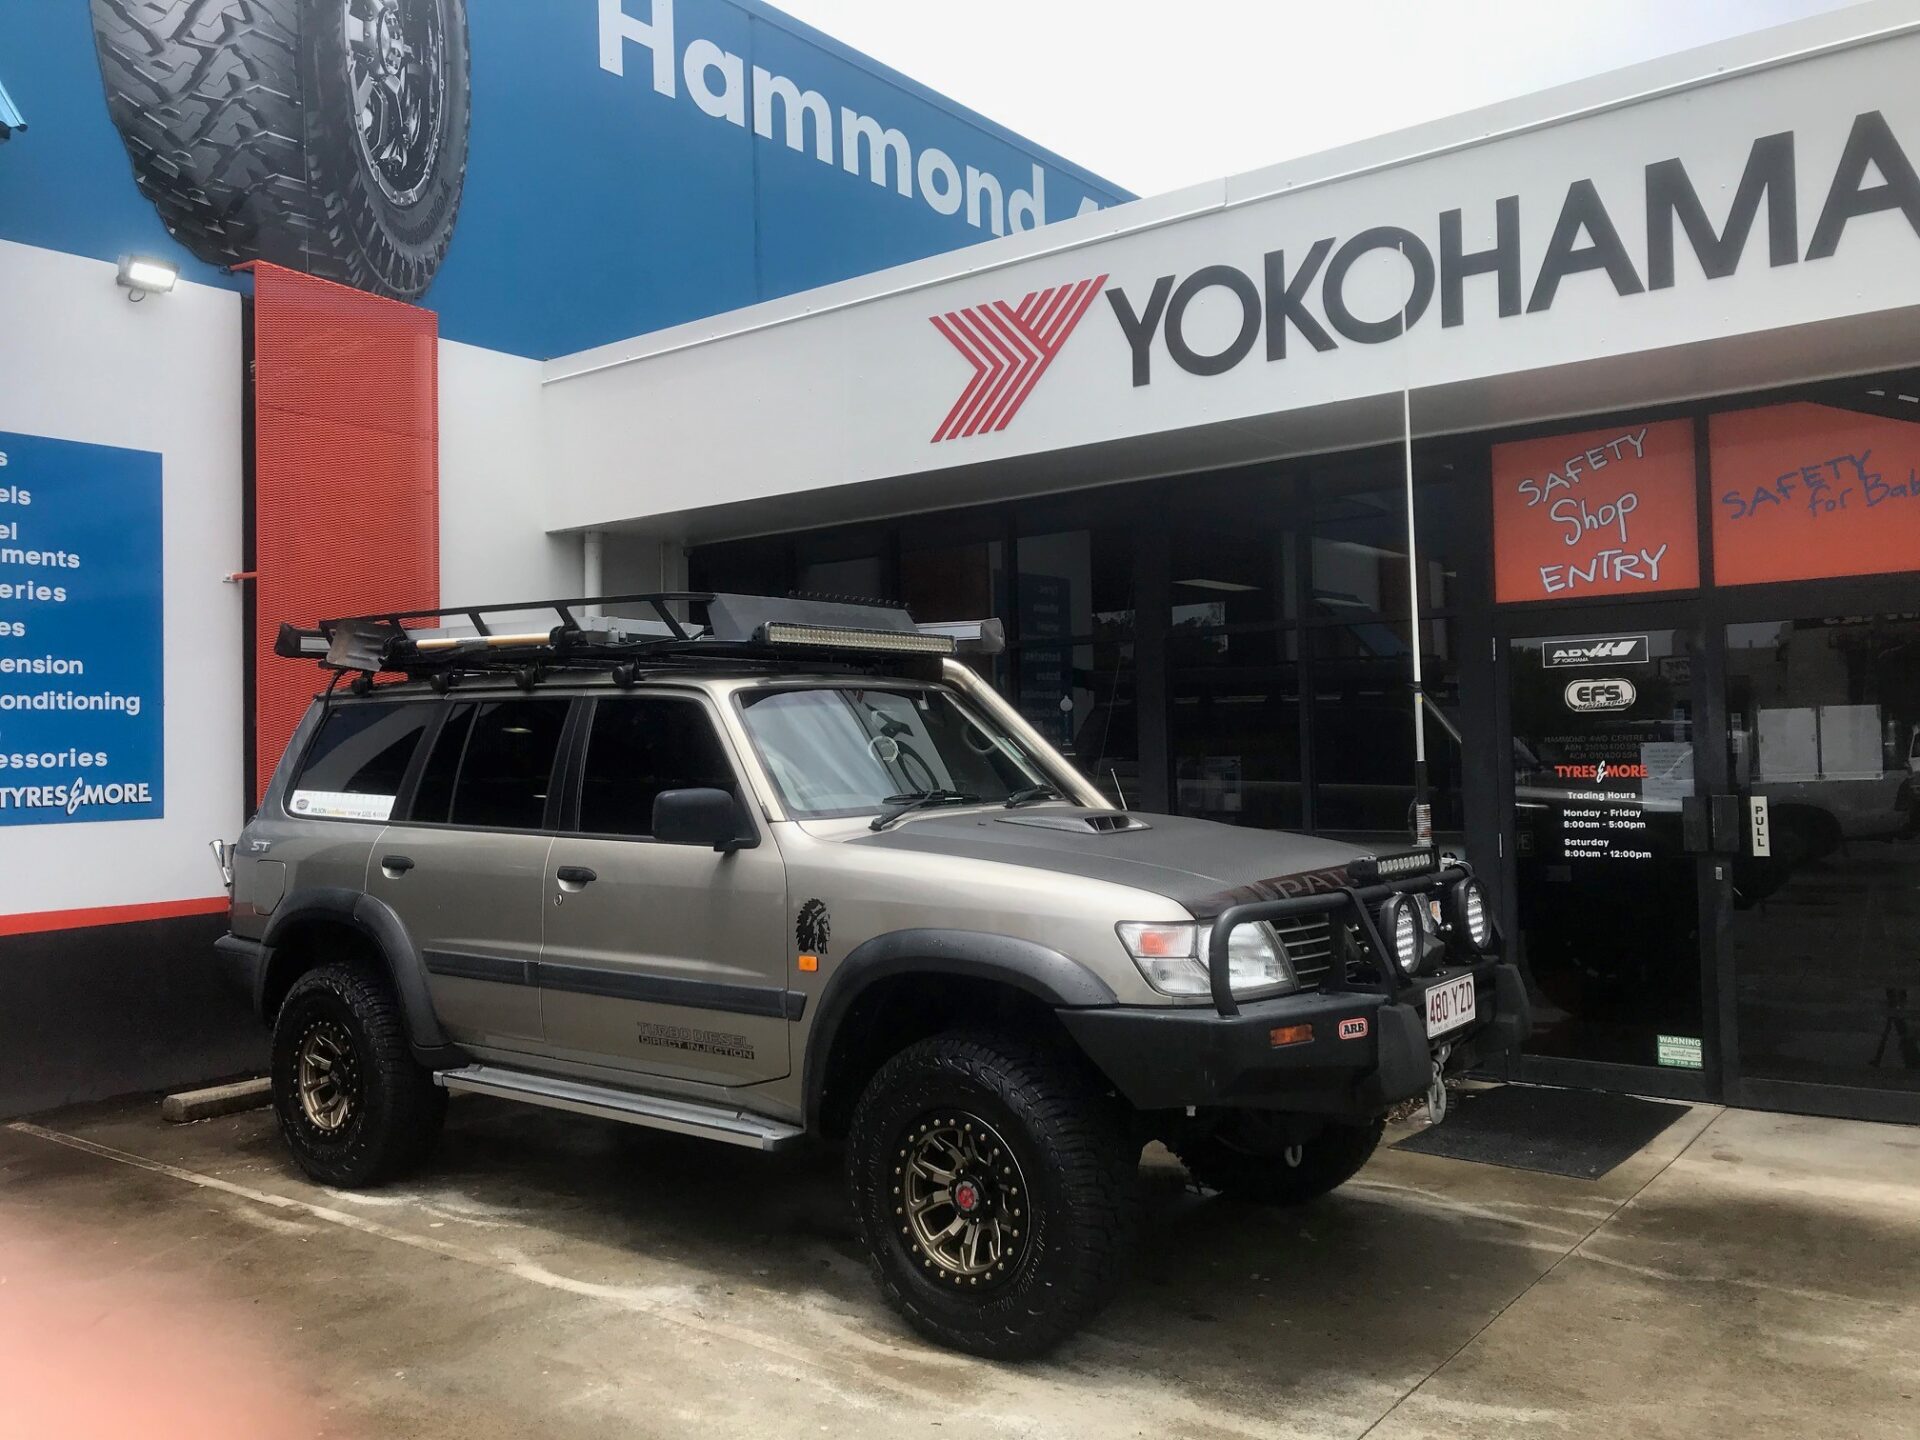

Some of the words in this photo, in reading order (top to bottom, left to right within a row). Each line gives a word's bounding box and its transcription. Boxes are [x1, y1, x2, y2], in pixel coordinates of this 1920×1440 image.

[598, 0, 1046, 237] Hammond
[1105, 110, 1920, 387] YOKOHAMA
[1518, 428, 1647, 506] SAFETY
[1722, 449, 1872, 520] SAFETY
[1808, 486, 1853, 518] for
[1550, 493, 1638, 546] Shop
[1, 547, 80, 569] ments
[1539, 544, 1667, 593] ENTRY
[0, 655, 84, 675] ension
[0, 691, 141, 716] onditioning
[1576, 685, 1622, 703] EFS
[1567, 792, 1605, 801] Trading
[1607, 791, 1636, 799] Hours
[1563, 809, 1601, 818] Monday
[1610, 809, 1642, 818] Friday
[1563, 820, 1600, 828] 8:00am
[1608, 820, 1646, 829] 5:00pm
[1755, 806, 1765, 847] PULL
[250, 840, 271, 853] ST
[1564, 838, 1609, 847] Saturday
[1564, 850, 1600, 858] 8:00am
[1610, 850, 1652, 859] 12:00pm
[1274, 868, 1352, 898] PAT
[1430, 991, 1449, 1024] 480
[1451, 982, 1473, 1016] YZD
[1343, 1022, 1365, 1035] ARB
[692, 1029, 754, 1050] DIESEL
[1659, 1035, 1702, 1047] WARNING
[687, 1042, 755, 1060] INJECTION
